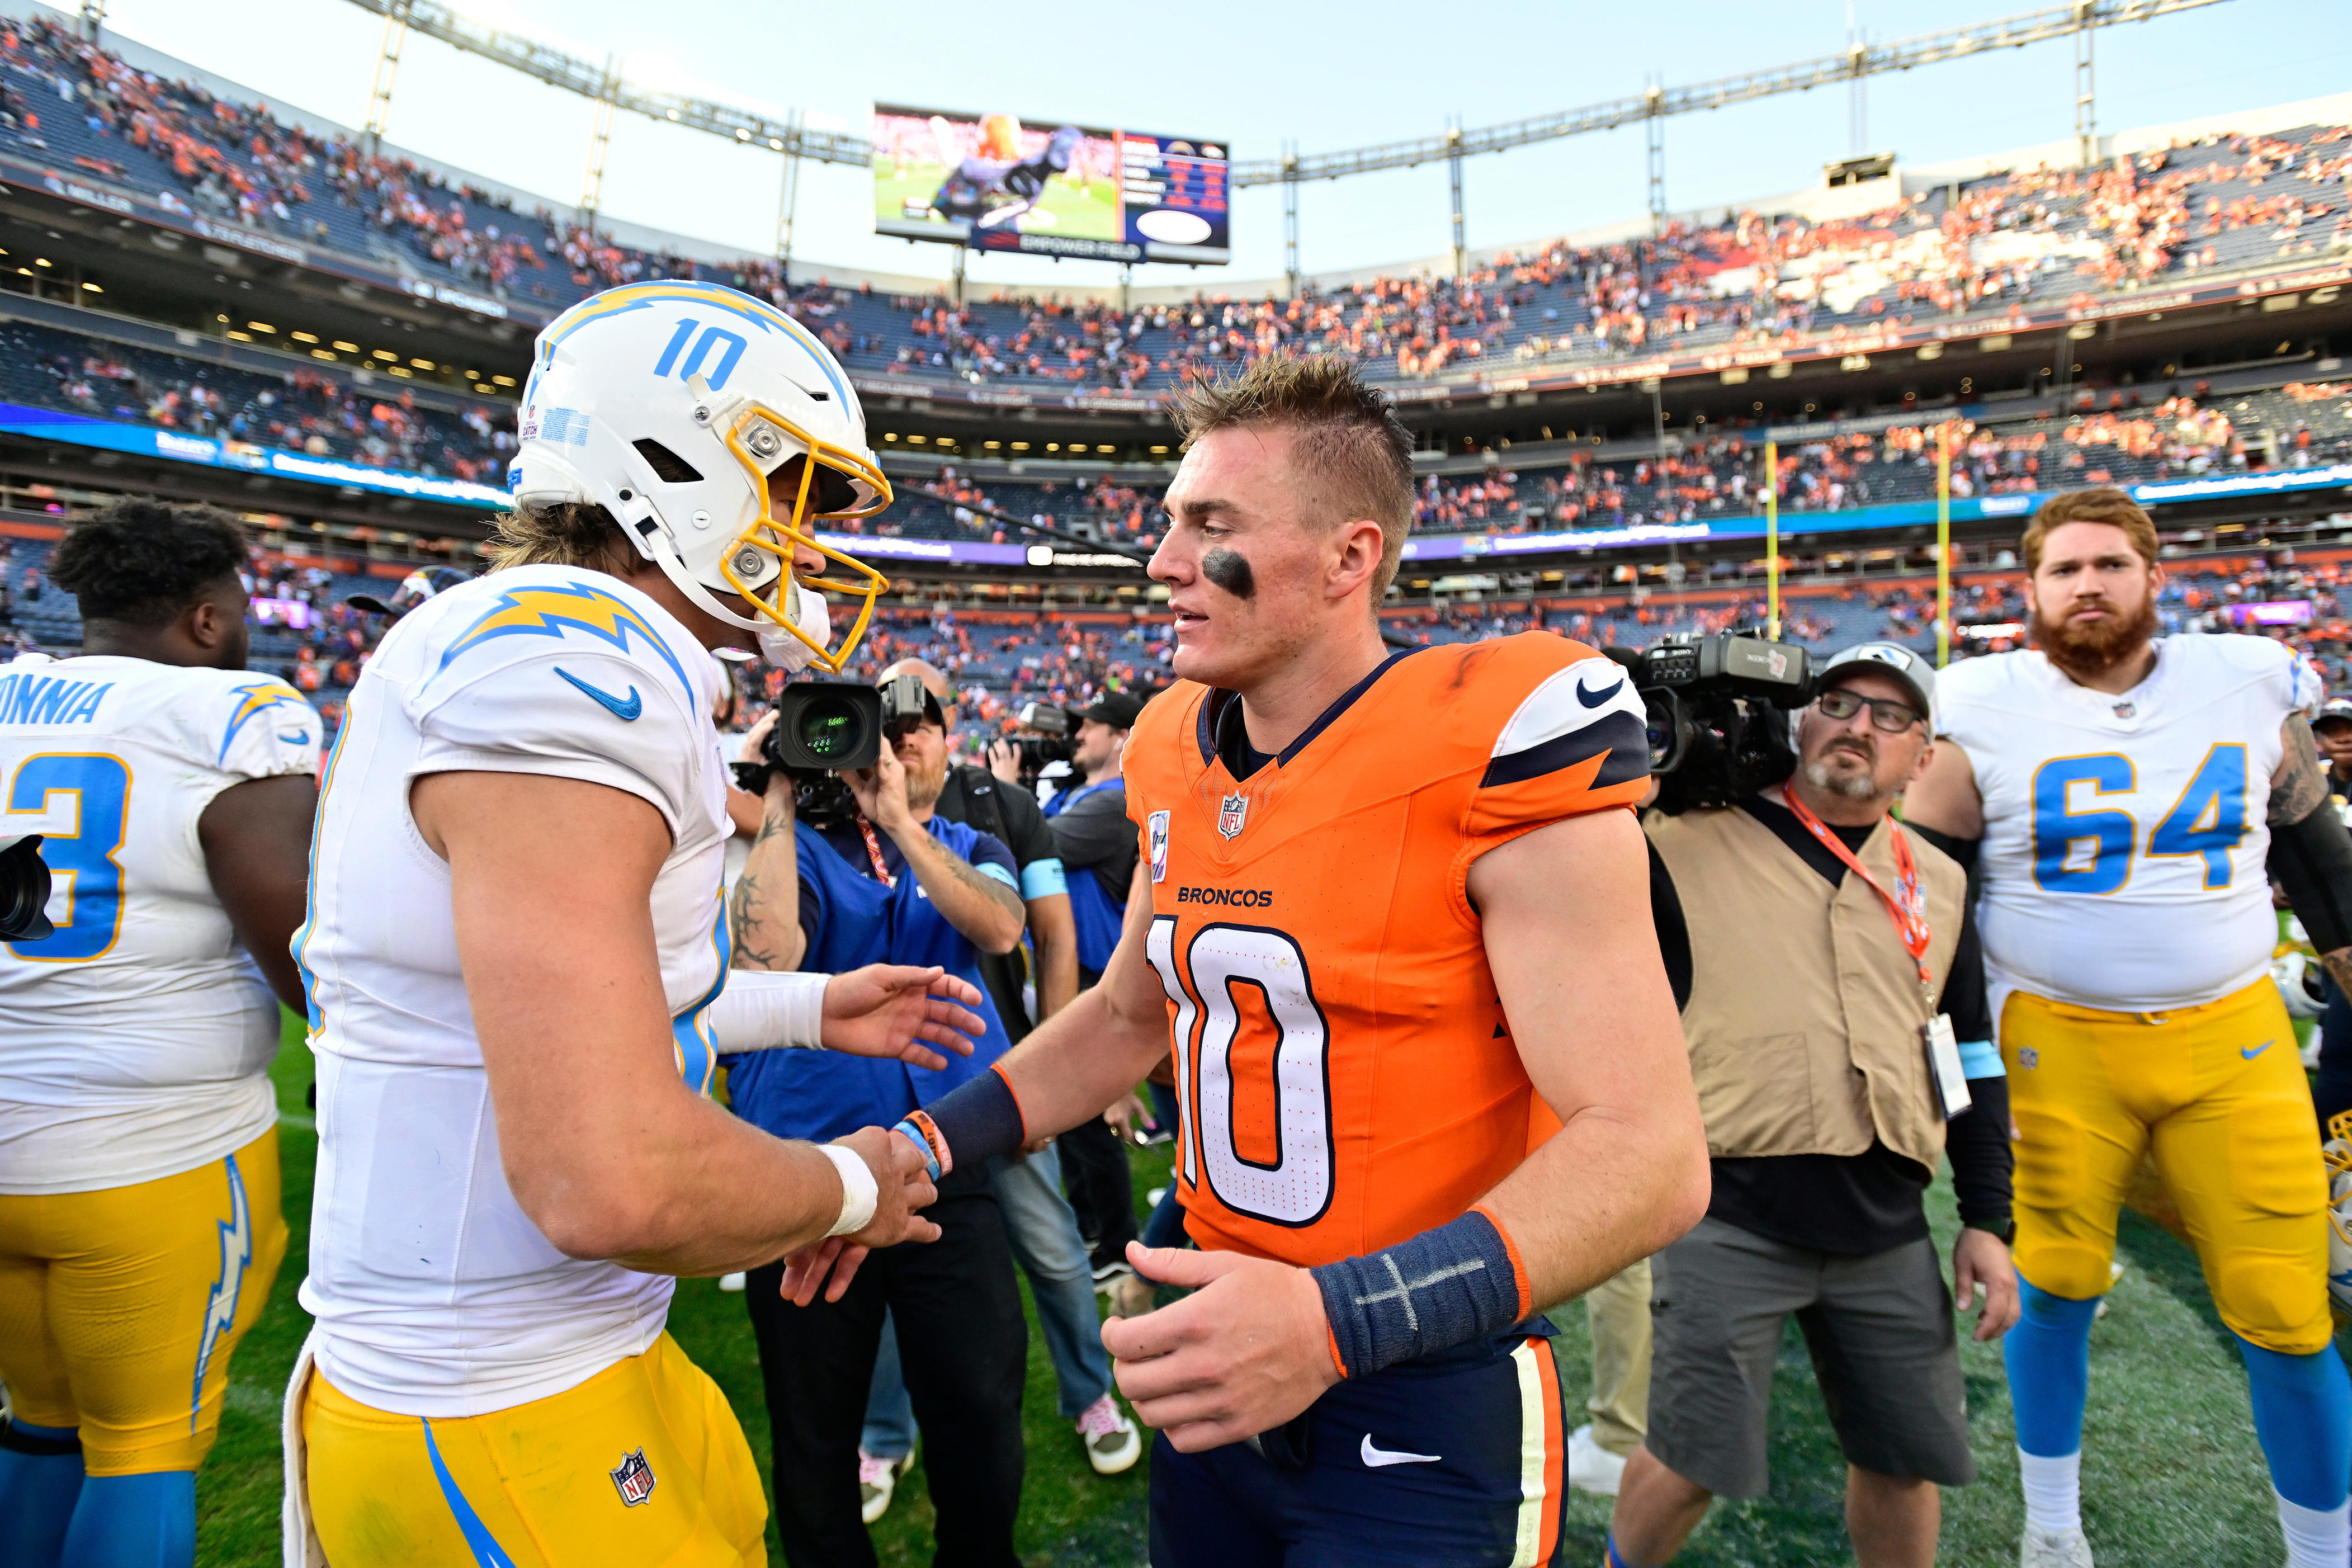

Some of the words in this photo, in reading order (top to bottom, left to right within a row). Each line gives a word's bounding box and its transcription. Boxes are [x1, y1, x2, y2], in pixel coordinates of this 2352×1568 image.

[653, 318, 748, 391] 10
[1222, 813, 1240, 832] NFL
[2032, 742, 2251, 896] 64
[1178, 887, 1273, 907] BRONCOS
[1145, 914, 1335, 1228] 10
[625, 1470, 652, 1499] NFL
